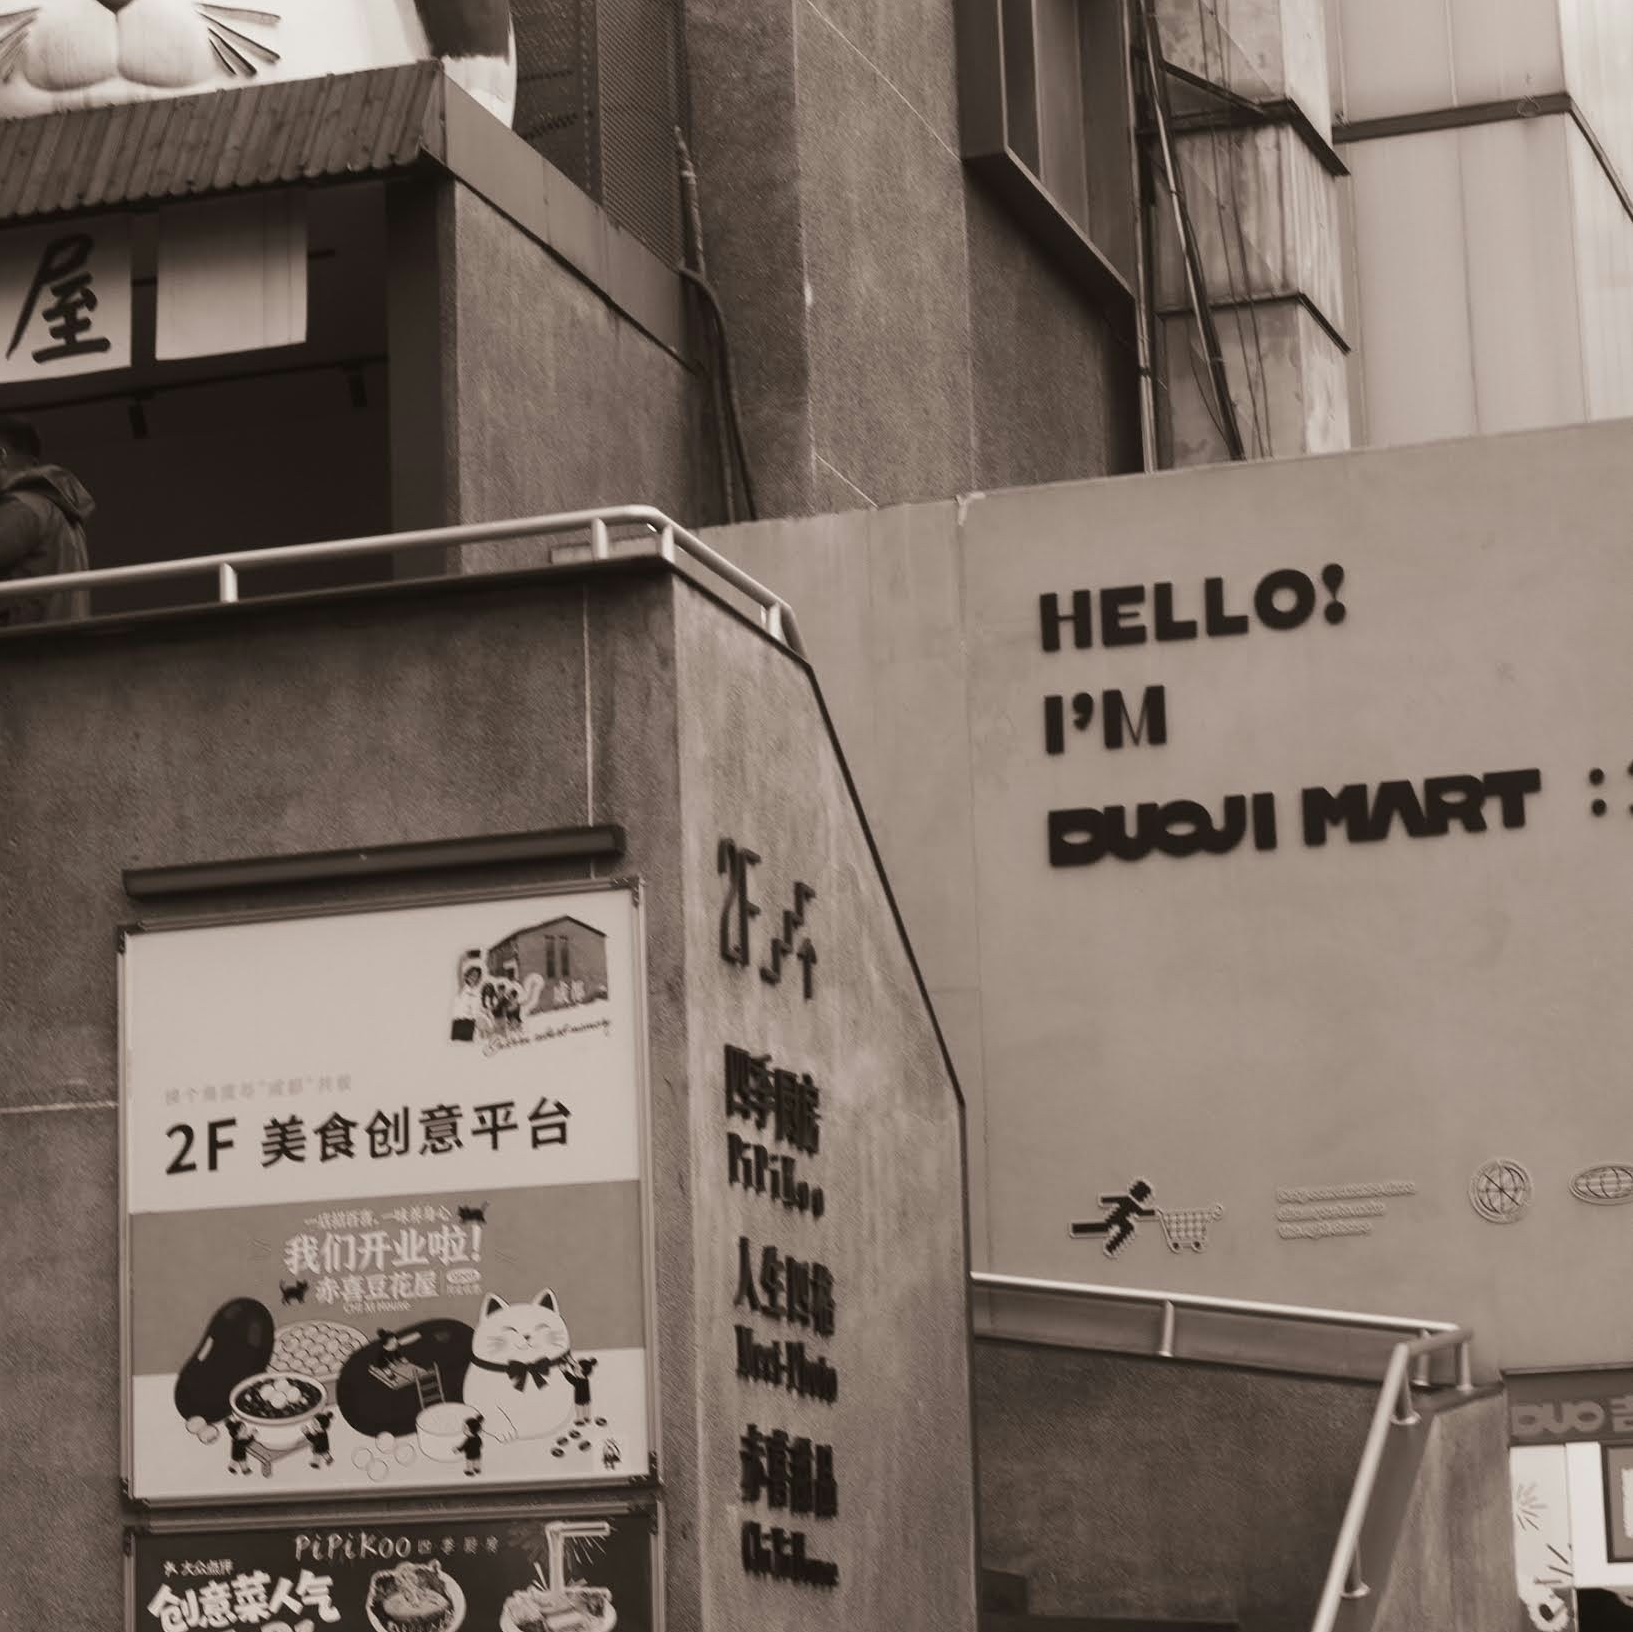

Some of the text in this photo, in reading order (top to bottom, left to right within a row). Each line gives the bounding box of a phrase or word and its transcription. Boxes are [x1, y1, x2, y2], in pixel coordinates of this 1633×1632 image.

[1039, 563, 1347, 653] HELLO!
[1048, 791, 1278, 868] DUOJI
[1302, 768, 1542, 847] MART
[164, 1096, 573, 1175] 2F 美食创意平台
